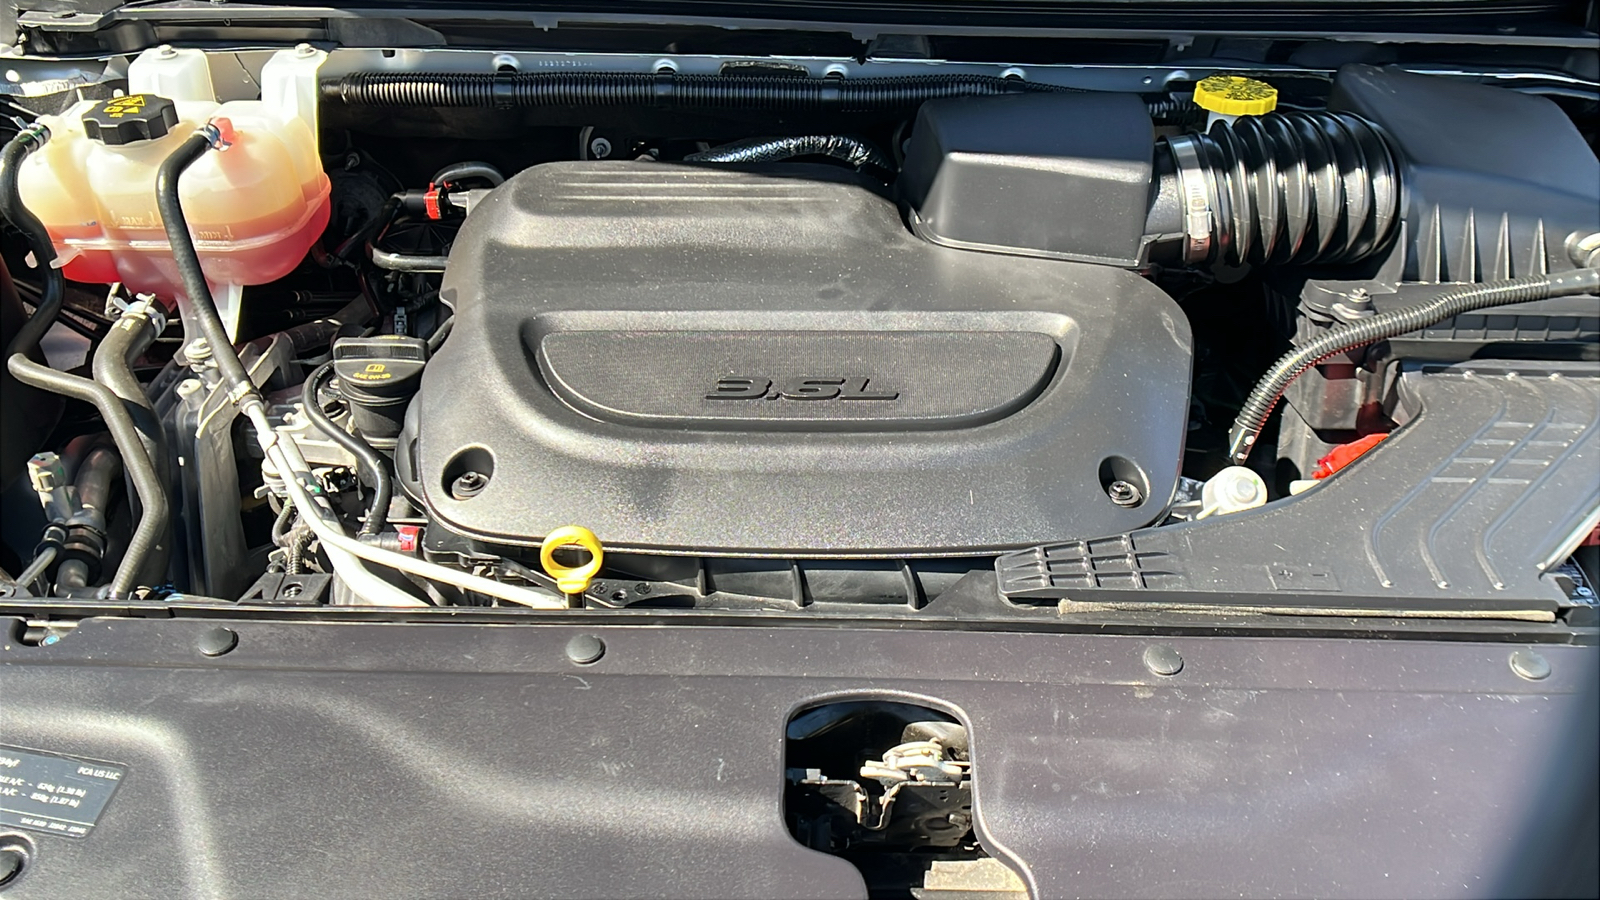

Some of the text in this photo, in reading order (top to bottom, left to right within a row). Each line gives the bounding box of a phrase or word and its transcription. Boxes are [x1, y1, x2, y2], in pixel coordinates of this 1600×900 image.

[705, 376, 899, 401] 3.6L
[77, 766, 122, 780] FCA US LLC
[8, 777, 25, 786] A/C
[2, 787, 18, 796] A/C
